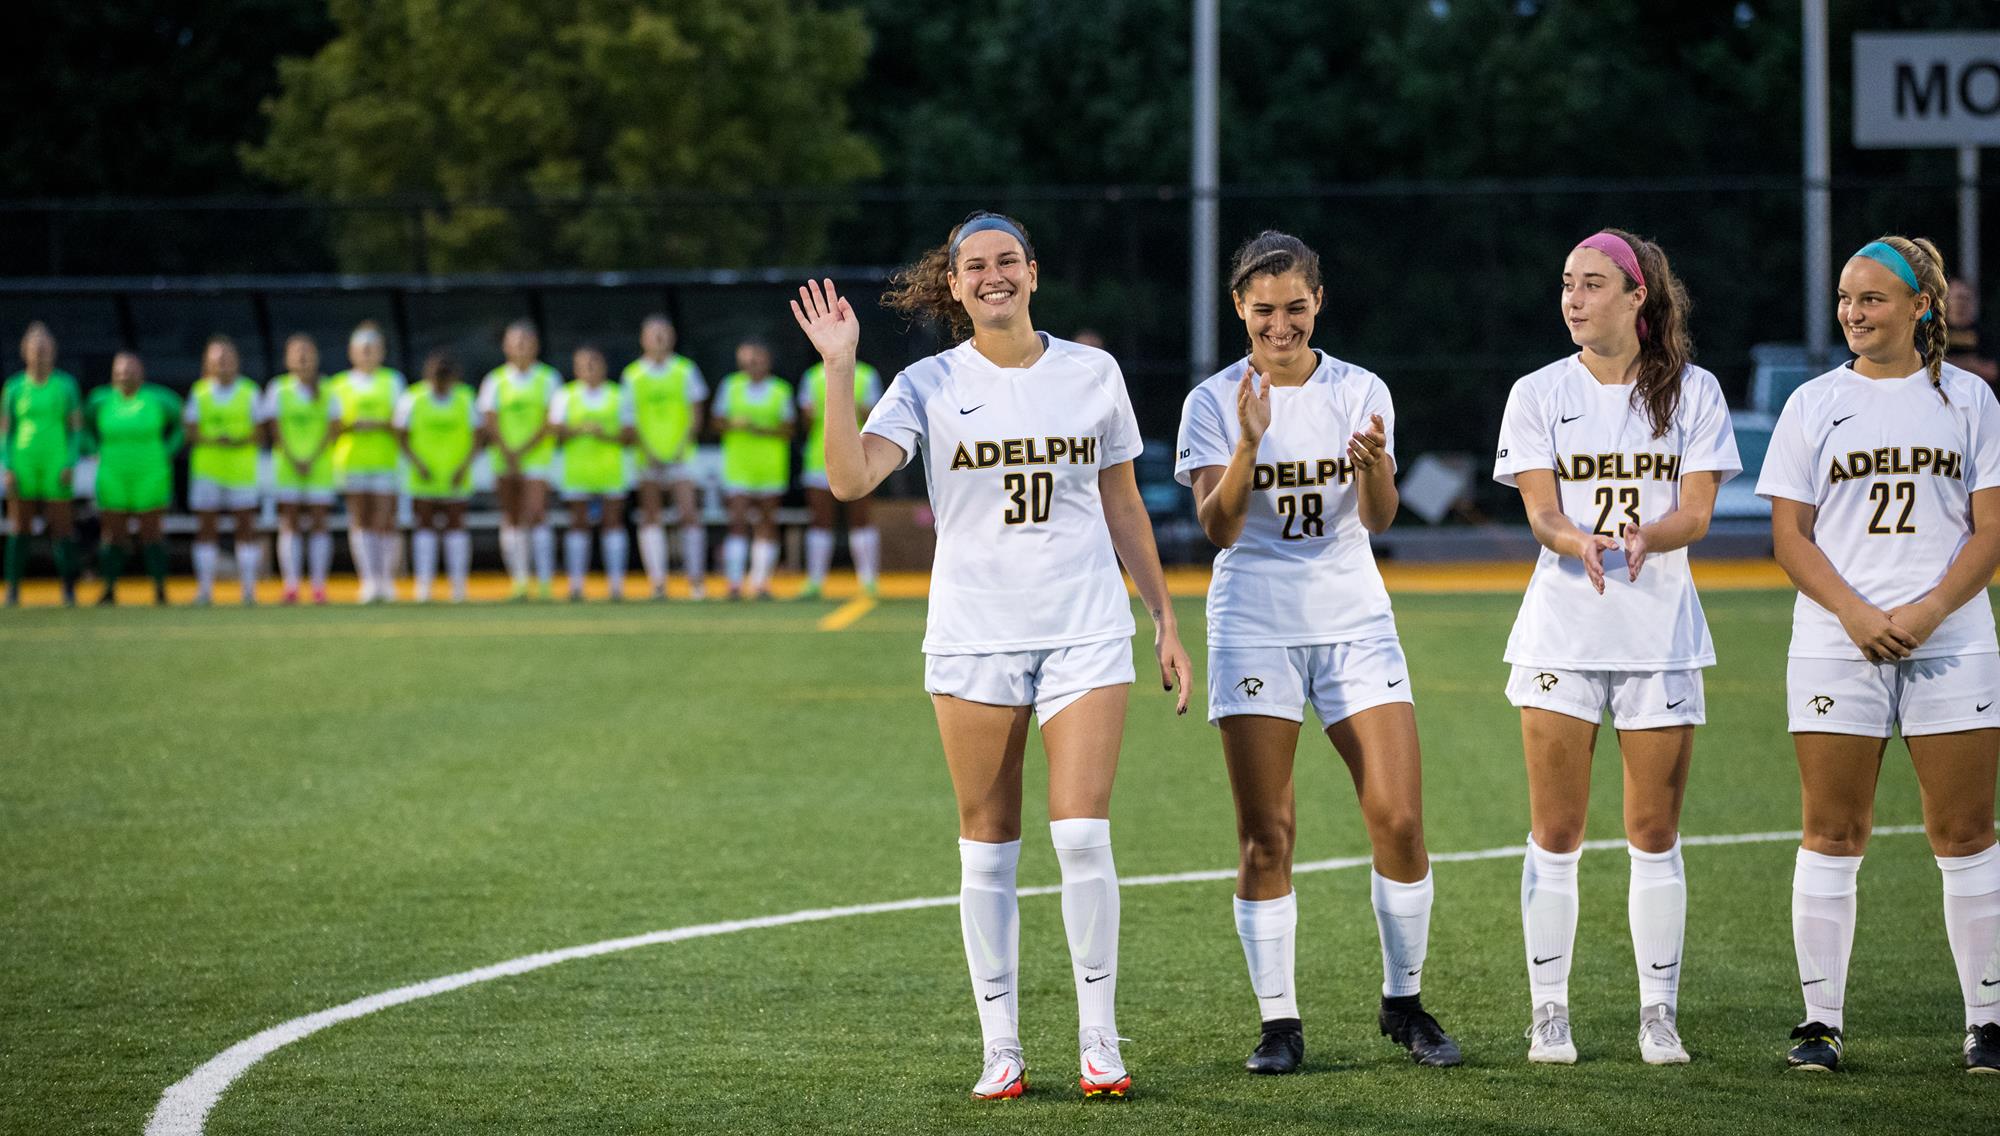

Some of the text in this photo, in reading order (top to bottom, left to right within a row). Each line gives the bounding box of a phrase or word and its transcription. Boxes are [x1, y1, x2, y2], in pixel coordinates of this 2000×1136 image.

[950, 436, 1096, 470] ADELPHI
[1252, 457, 1356, 491] DELPH
[1830, 447, 1962, 484] ADELPHI
[1004, 472, 1053, 525] 30
[1278, 493, 1324, 539] 28
[1593, 487, 1640, 538] 23
[1868, 481, 1915, 534] 22
